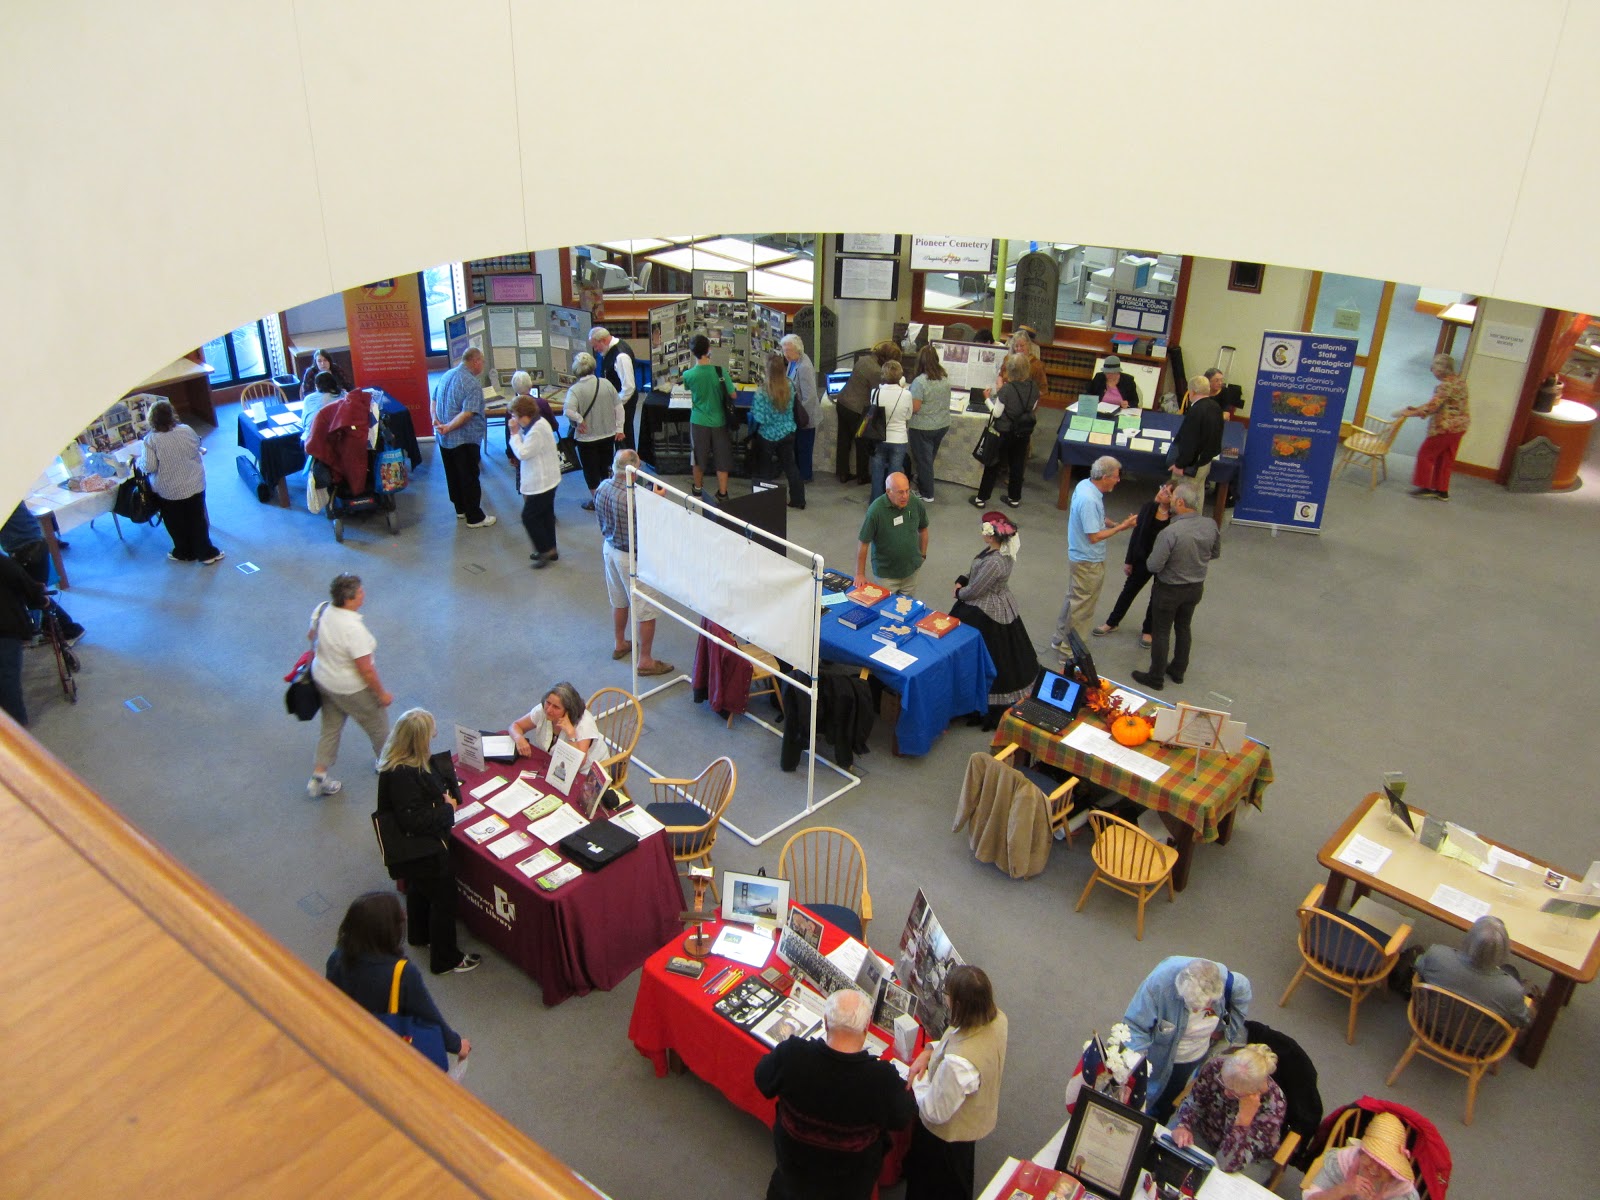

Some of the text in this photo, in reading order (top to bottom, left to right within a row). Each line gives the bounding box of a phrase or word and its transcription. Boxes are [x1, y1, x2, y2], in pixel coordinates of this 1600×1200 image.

[915, 238, 990, 250] Pioneer Cemetery
[1119, 295, 1157, 304] GENEALOGICAL
[357, 303, 395, 311] SOCIETY
[1116, 299, 1169, 310] HISTORICAL COUNCIL
[358, 311, 409, 319] CALIFORNIA
[360, 320, 410, 328] ARCHIVISTS
[796, 320, 834, 329] SHEON
[1311, 342, 1347, 352] California
[1318, 351, 1337, 359] State
[1301, 357, 1352, 368] Genealogical
[1309, 366, 1340, 375] Alliance
[1271, 373, 1334, 385] Uniting California's
[1257, 379, 1346, 394] Genealogical Community
[1273, 417, 1318, 426] www.csga.com
[1274, 460, 1301, 469] Promoting
[485, 906, 513, 931] Library
